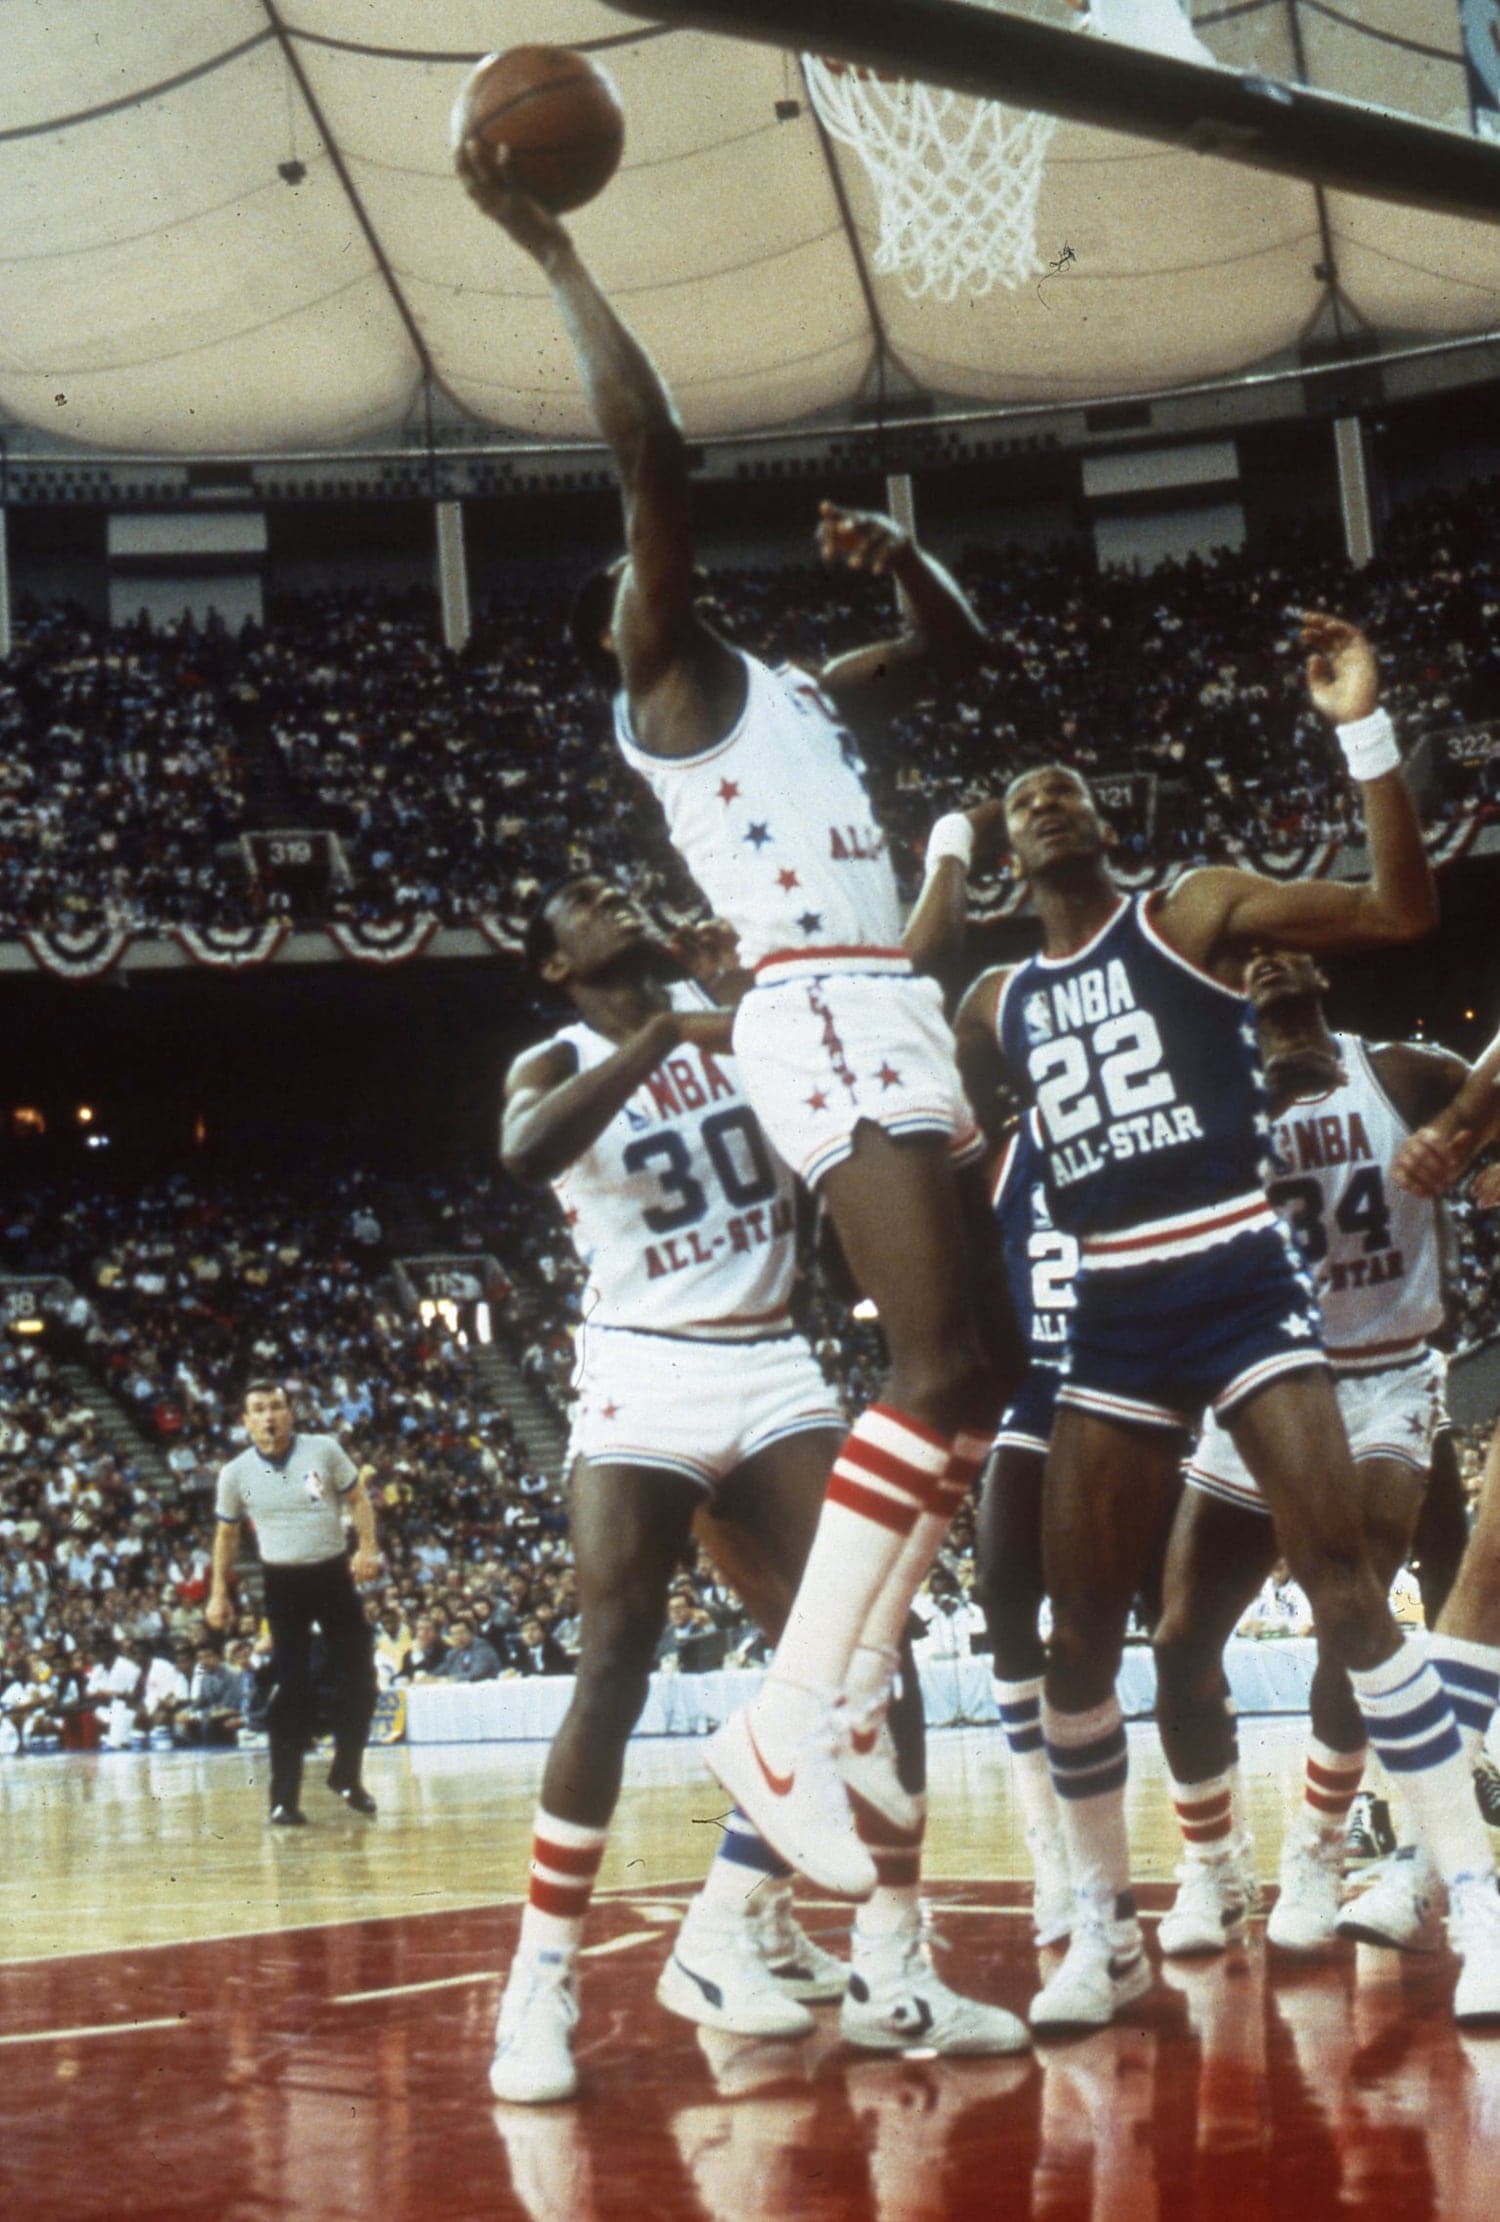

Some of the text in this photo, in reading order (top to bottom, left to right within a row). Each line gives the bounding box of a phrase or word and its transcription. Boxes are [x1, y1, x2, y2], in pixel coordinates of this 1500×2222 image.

[1052, 958, 1136, 1033] NBA
[646, 1049, 736, 1120] NBA
[1028, 1009, 1176, 1145] 22
[622, 1104, 776, 1235] 30
[1050, 1105, 1204, 1188] ALL-STAR
[1293, 1112, 1373, 1170] NBA
[1267, 1165, 1391, 1264] 34
